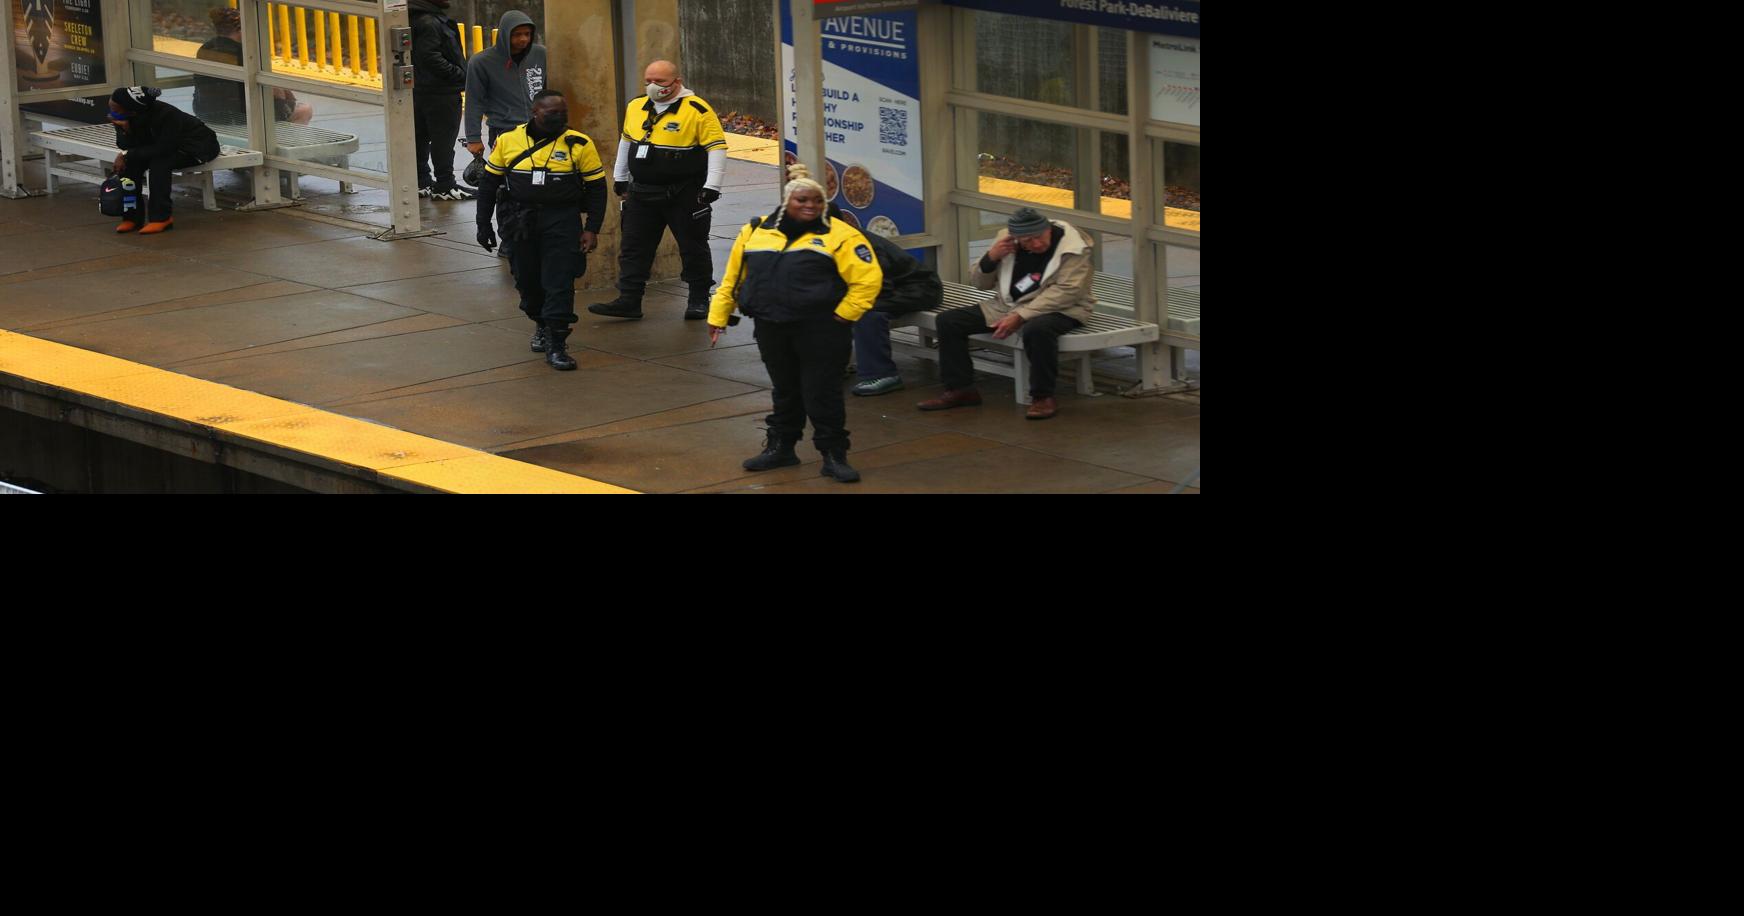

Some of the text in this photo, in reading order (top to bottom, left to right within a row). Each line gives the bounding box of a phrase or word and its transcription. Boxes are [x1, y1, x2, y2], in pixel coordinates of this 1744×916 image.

[1060, 0, 1199, 23] Forest Park-DeBaliviere
[64, 21, 92, 35] SKELETON
[825, 15, 905, 42] AVENUE
[71, 34, 87, 47] CREW
[828, 41, 907, 59] & PROVISIONS
[822, 87, 860, 102] BUILD A
